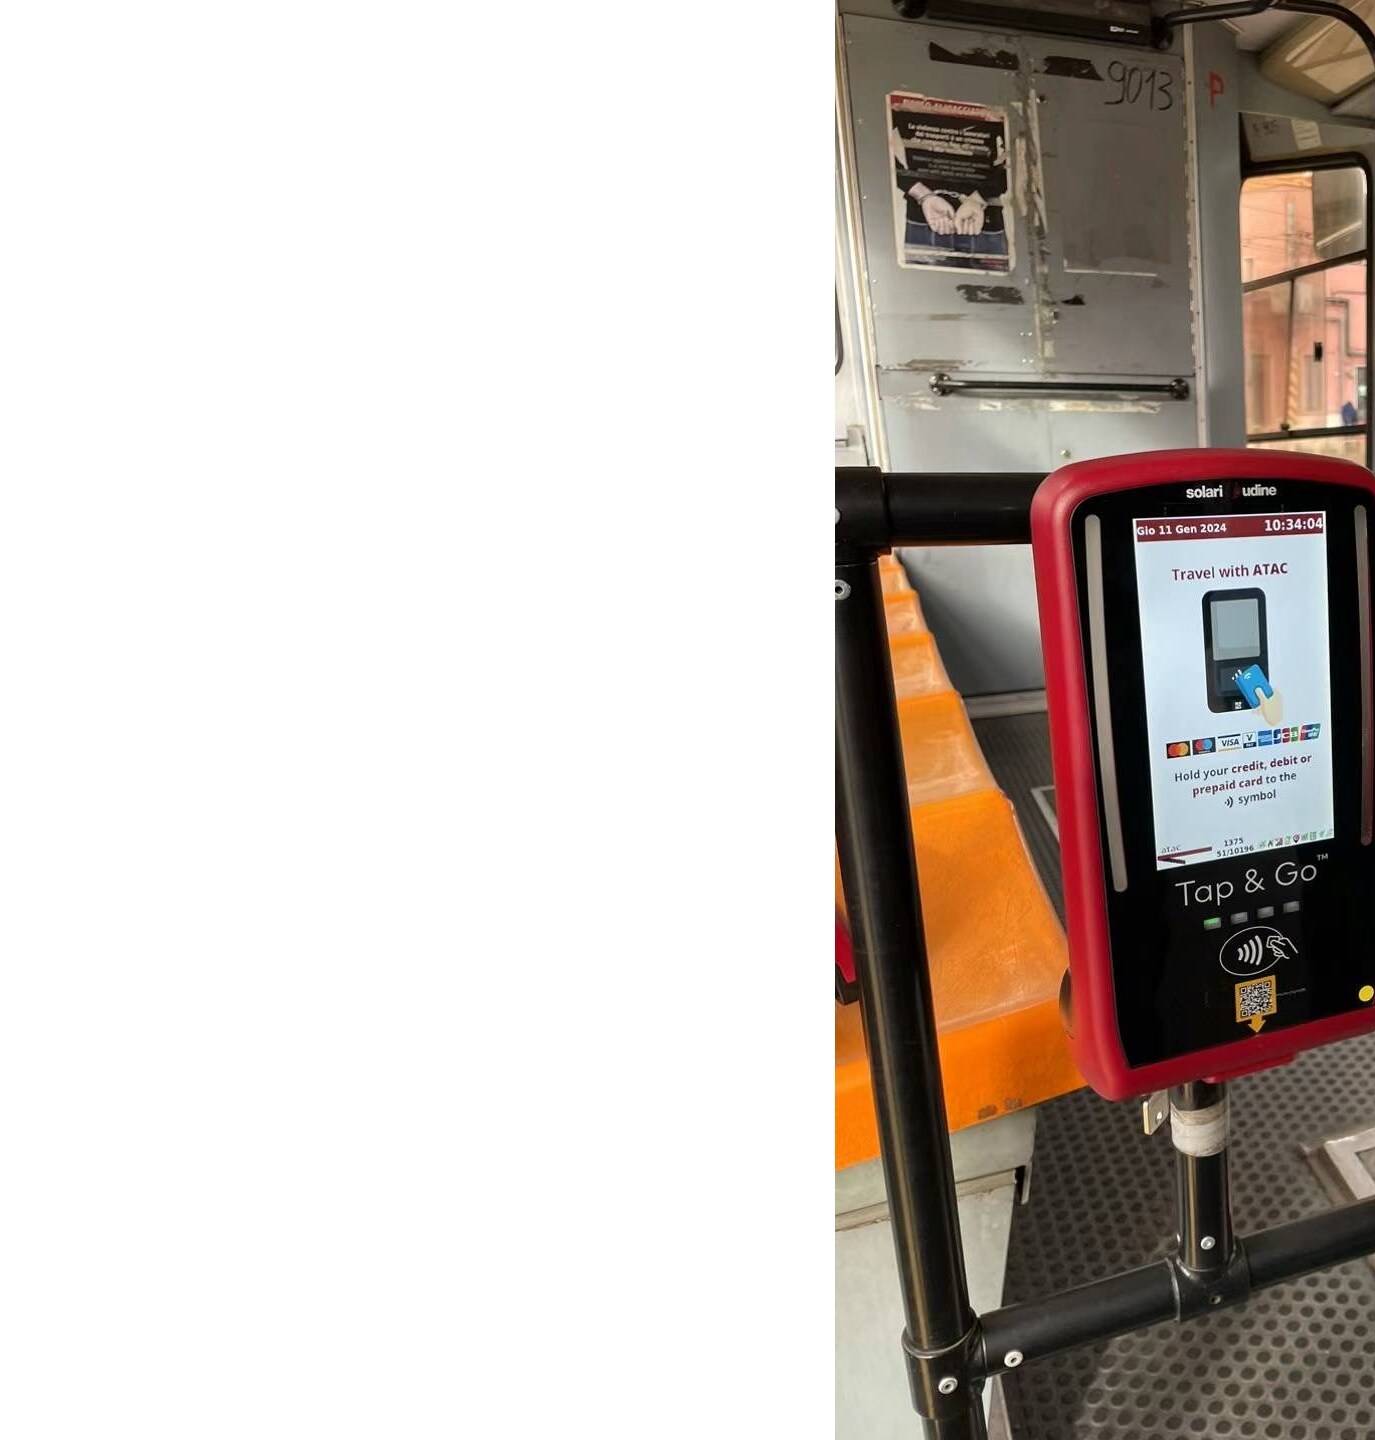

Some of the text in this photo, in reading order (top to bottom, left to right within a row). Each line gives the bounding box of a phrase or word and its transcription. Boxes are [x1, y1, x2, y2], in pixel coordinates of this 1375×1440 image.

[1104, 60, 1173, 111] 9013
[1186, 484, 1277, 499] solari udine
[1137, 523, 1227, 536] Gio 11 Gen 2024
[1264, 518, 1324, 532] 10:34:04
[1172, 562, 1288, 581] Travel with ATAC
[1221, 738, 1240, 748] VISA
[1174, 754, 1312, 782] Hold your credit, debit or
[1192, 772, 1297, 798] prepaid card to the
[1238, 790, 1276, 806] symbol
[1224, 838, 1244, 847] 1375
[1174, 880, 1234, 906] Tap
[1244, 868, 1266, 893] &
[1274, 861, 1317, 887] Go
